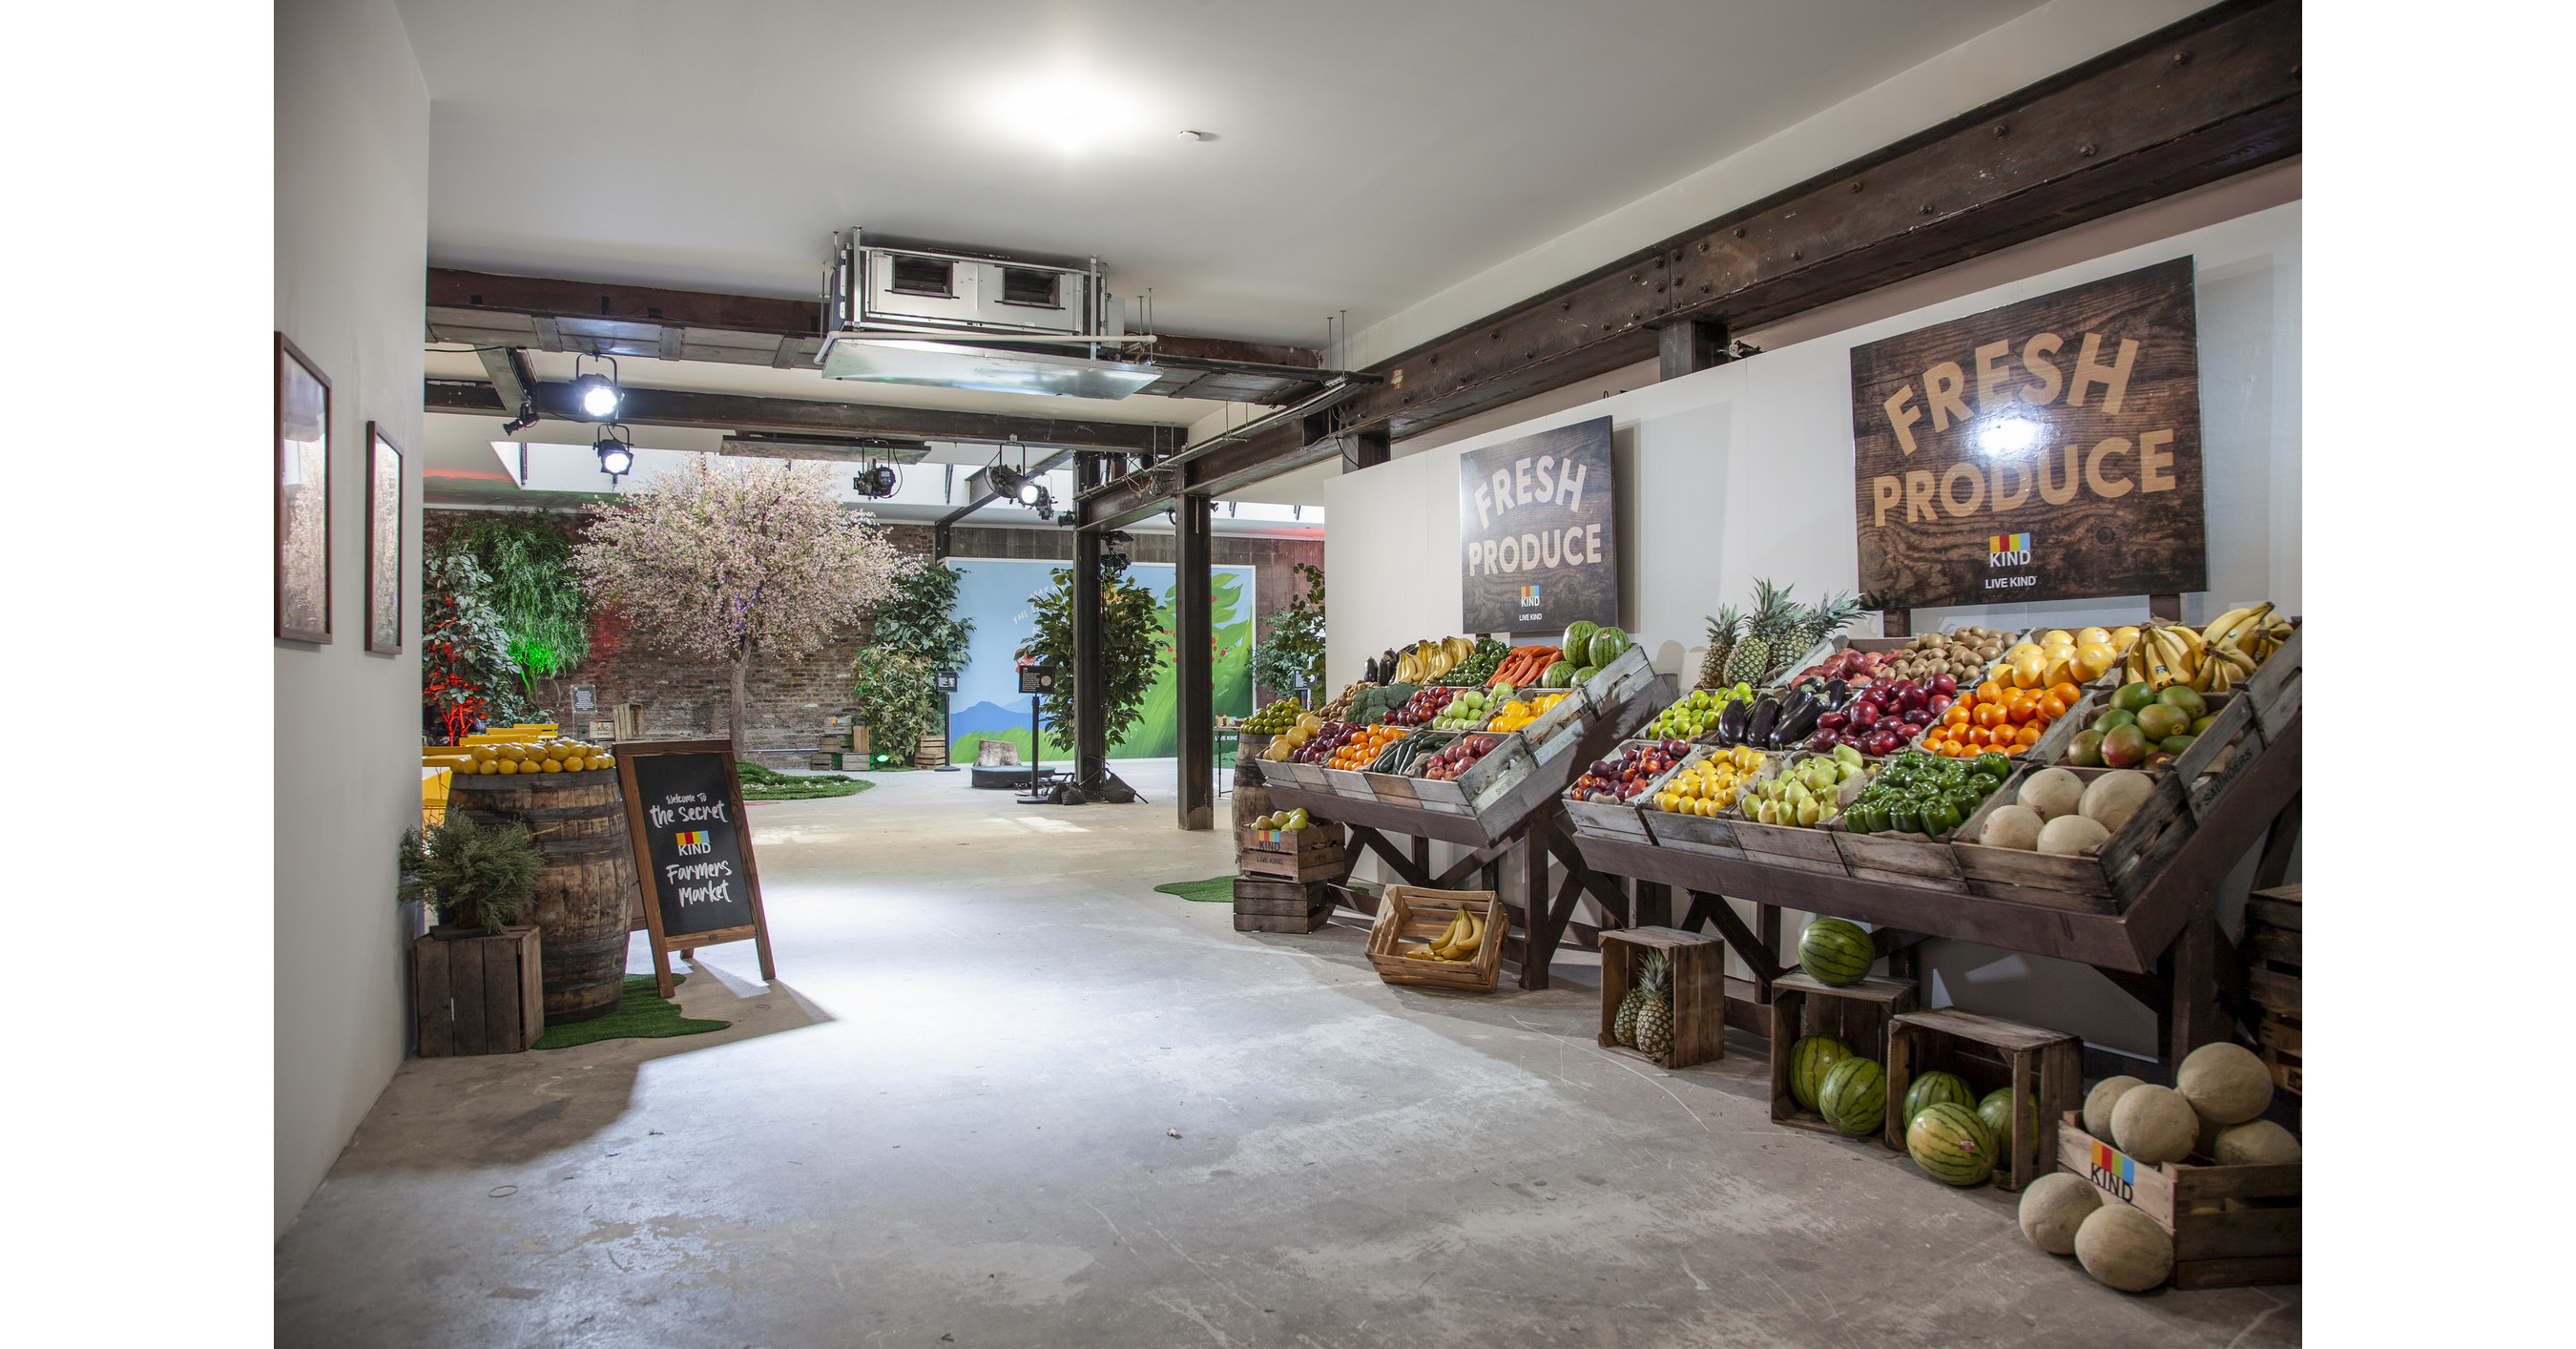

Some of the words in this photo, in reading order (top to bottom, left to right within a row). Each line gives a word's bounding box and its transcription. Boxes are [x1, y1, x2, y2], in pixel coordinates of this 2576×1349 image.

[1883, 332, 2139, 457] FRESH
[1873, 428, 2176, 528] PRODUCE
[1475, 455, 1588, 529] FRESH
[1468, 524, 1602, 576] PRODUCE
[1989, 550, 2031, 568] KIND
[1984, 577, 2008, 589] LIVE
[1521, 596, 1541, 608] KIND
[1519, 613, 1530, 622] LIVE
[1530, 612, 1543, 621] KIND
[2204, 748, 2253, 806] SAUNDERS
[665, 793, 696, 805] Welcome
[650, 804, 675, 829] the
[678, 843, 713, 857] KIND
[1258, 841, 1281, 851] KIND
[1256, 856, 1269, 864] LIVE
[1269, 857, 1283, 865] KIND
[666, 861, 733, 885] Farmers
[2090, 1162, 2134, 1204] KIND
